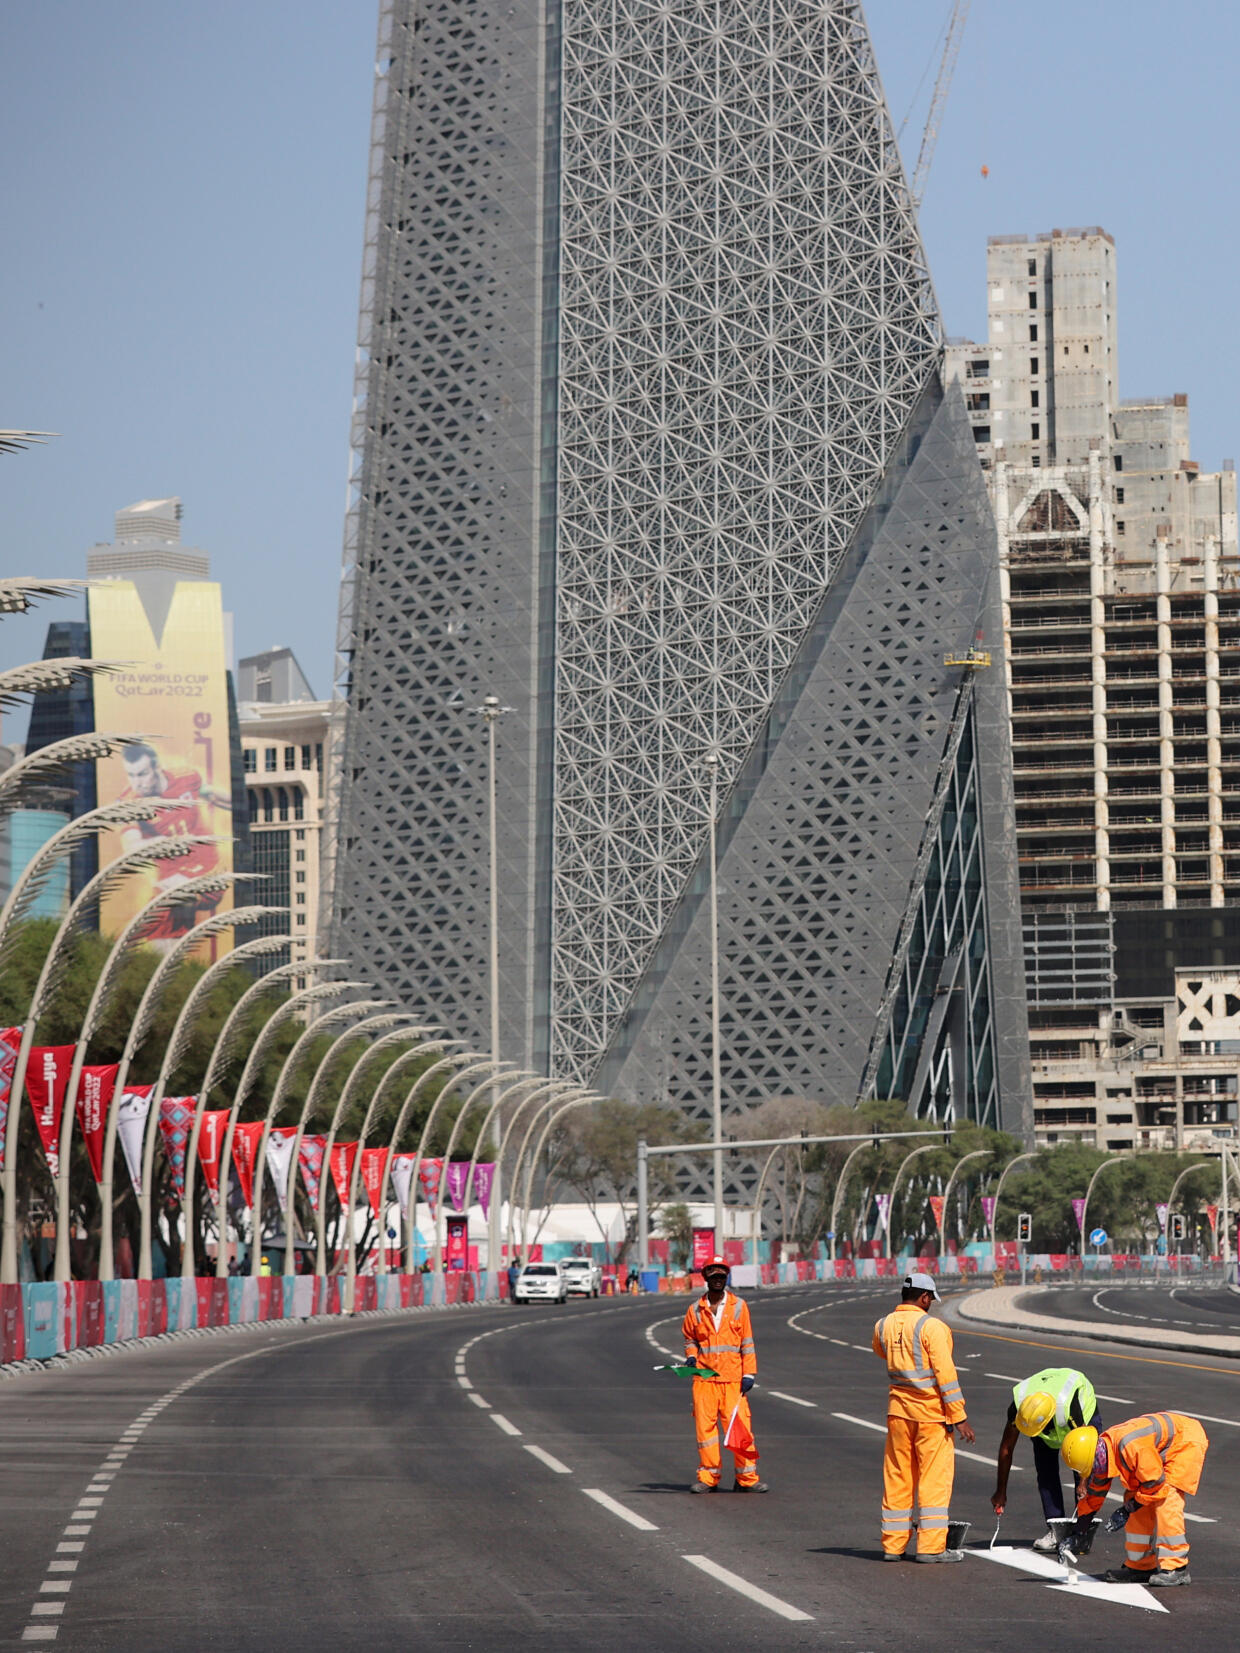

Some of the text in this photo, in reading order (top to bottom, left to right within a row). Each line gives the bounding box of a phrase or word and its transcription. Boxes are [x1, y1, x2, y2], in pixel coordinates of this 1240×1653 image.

[109, 674, 209, 683] FIFA WORLD CUP
[40, 1052, 57, 1126] Hayya
[84, 1072, 92, 1089] CUP
[84, 1089, 92, 1116] WORLD
